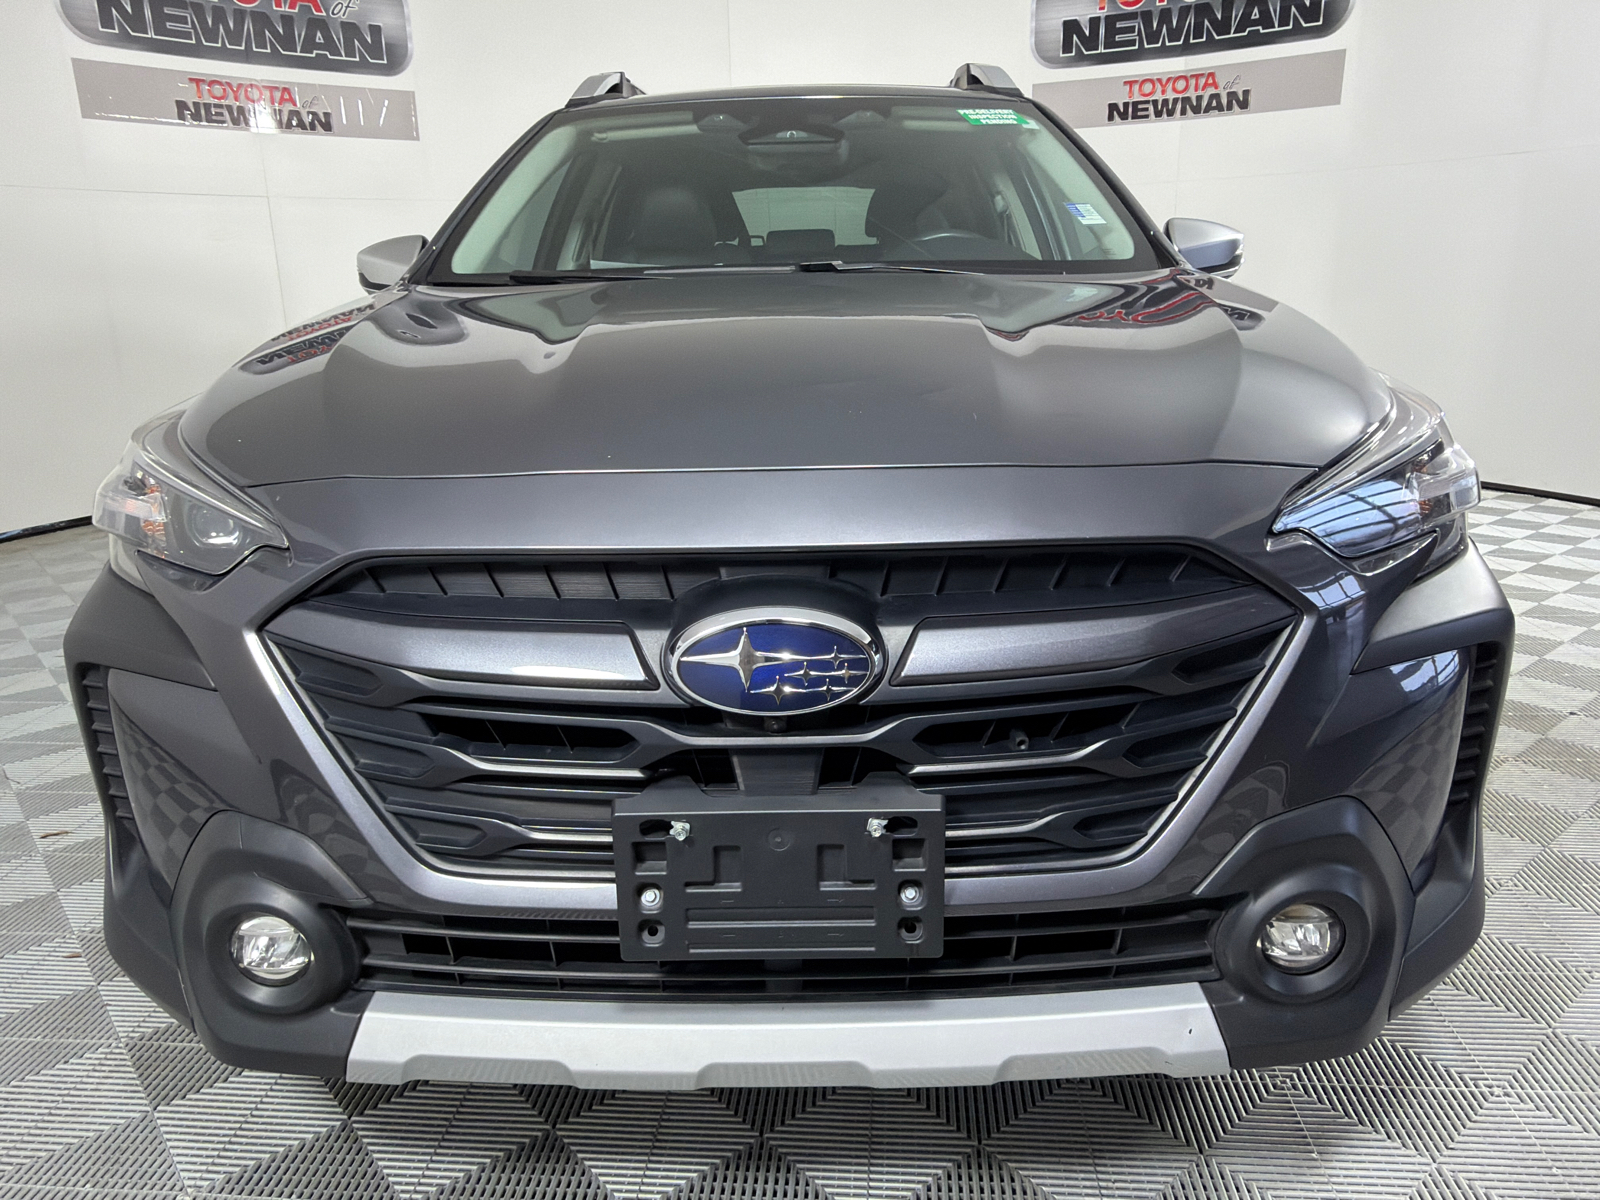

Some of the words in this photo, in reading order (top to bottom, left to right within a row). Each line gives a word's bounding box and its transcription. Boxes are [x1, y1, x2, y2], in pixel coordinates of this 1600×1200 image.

[98, 0, 388, 63] NEWNAN
[1059, 0, 1324, 58] NEWNAN
[187, 77, 298, 108] TOYOTA
[301, 95, 320, 110] of
[1122, 71, 1220, 99] TOYOTA
[1222, 74, 1240, 91] of
[1107, 88, 1251, 122] NEWNAN
